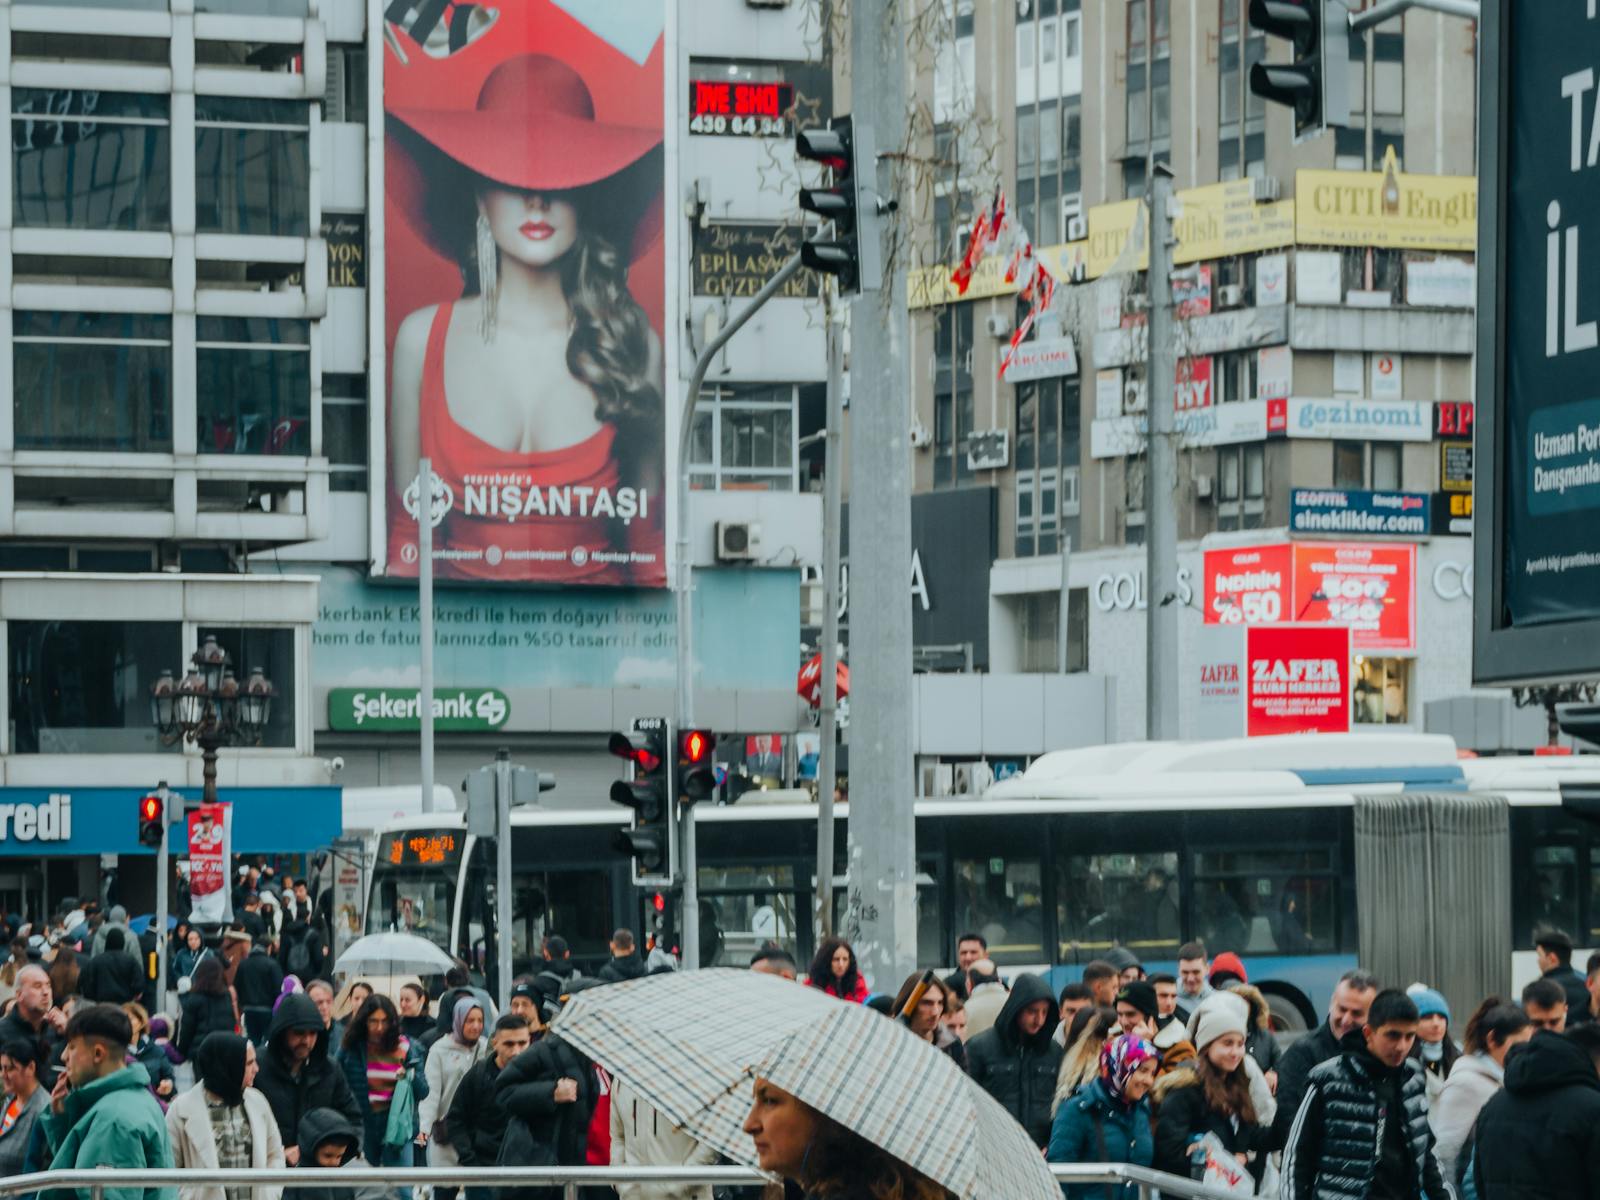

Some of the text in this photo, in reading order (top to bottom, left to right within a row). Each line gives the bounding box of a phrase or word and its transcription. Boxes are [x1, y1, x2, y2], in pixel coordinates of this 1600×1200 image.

[690, 116, 726, 134] 430
[1313, 184, 1376, 215] CITI
[1175, 379, 1210, 411] HY
[1298, 400, 1423, 428] gezinomi
[1534, 423, 1600, 460] Uzman Por
[1534, 456, 1600, 495] Danışmanla
[464, 485, 647, 525] NİŞANTAŞI
[1294, 508, 1425, 533] sineklikler.com
[318, 605, 393, 623] kerbank
[399, 605, 480, 624] EKkredi
[484, 606, 505, 624] ile
[510, 606, 548, 624] hem
[552, 606, 610, 628] doğayı
[312, 629, 349, 646] hem
[354, 629, 376, 646] de
[381, 629, 519, 647] faturlarınızdan
[524, 631, 564, 648] %50
[568, 631, 638, 648] tasarruf
[1200, 663, 1240, 683] ZAFER
[1252, 658, 1341, 681] ZAFER
